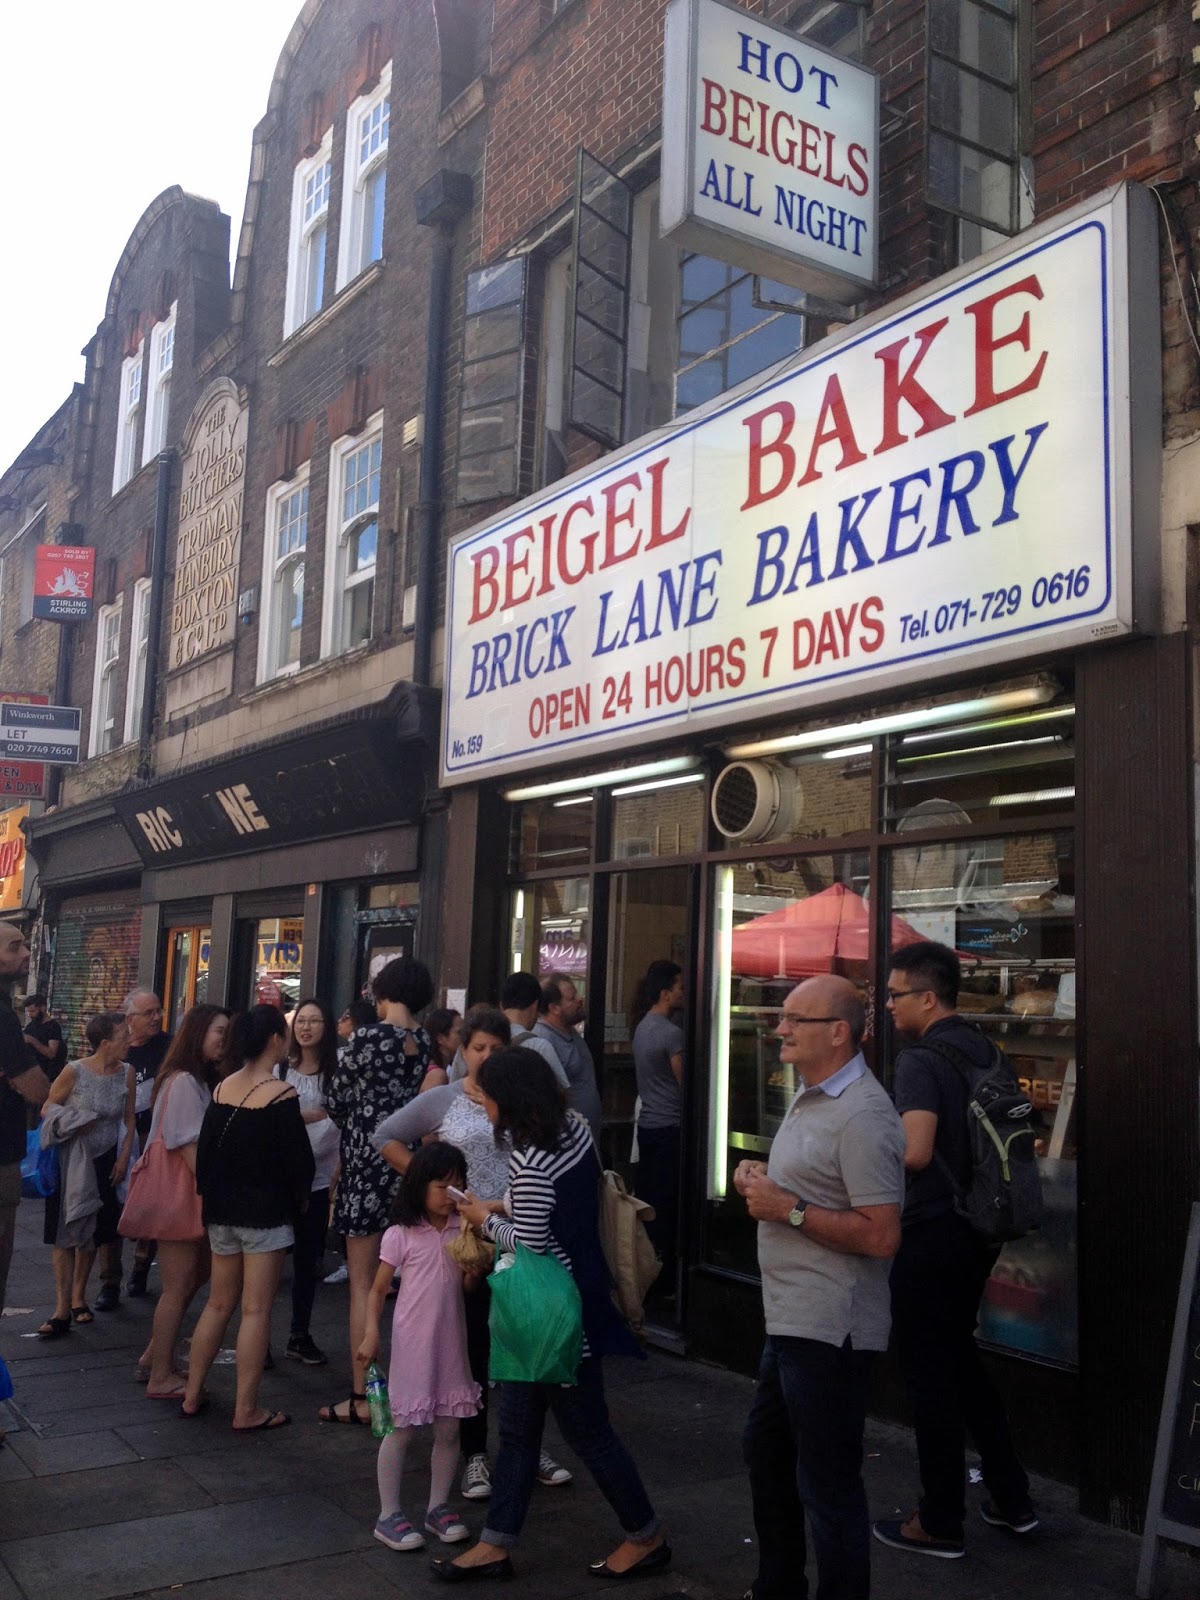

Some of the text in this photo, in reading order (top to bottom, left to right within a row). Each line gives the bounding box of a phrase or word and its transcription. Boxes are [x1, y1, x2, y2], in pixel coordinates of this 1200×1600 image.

[737, 31, 839, 110] HOT
[700, 76, 869, 197] BEIGELS
[700, 158, 867, 257] ALL NIGHT
[189, 417, 240, 483] JOLLY
[205, 405, 227, 438] THE
[467, 274, 1049, 626] BEIGEL BAKE
[180, 445, 246, 521] BUTCHERS
[178, 492, 243, 565] TRUMAN
[466, 421, 1050, 700] BRICK LANE BAKERY
[175, 529, 240, 601] HANBURY
[50, 599, 87, 607] STIRLING
[50, 607, 87, 615] ACKROYD
[172, 567, 237, 636] BUXTON
[900, 565, 1090, 643] Tel. 071-729 0616
[528, 596, 885, 739] OPEN 24 HOURS 7 DAYS
[7, 729, 28, 740] LET
[7, 743, 25, 752] 020
[26, 745, 48, 754] 7749
[50, 746, 73, 756] 7650
[9, 709, 55, 721] Winkworth
